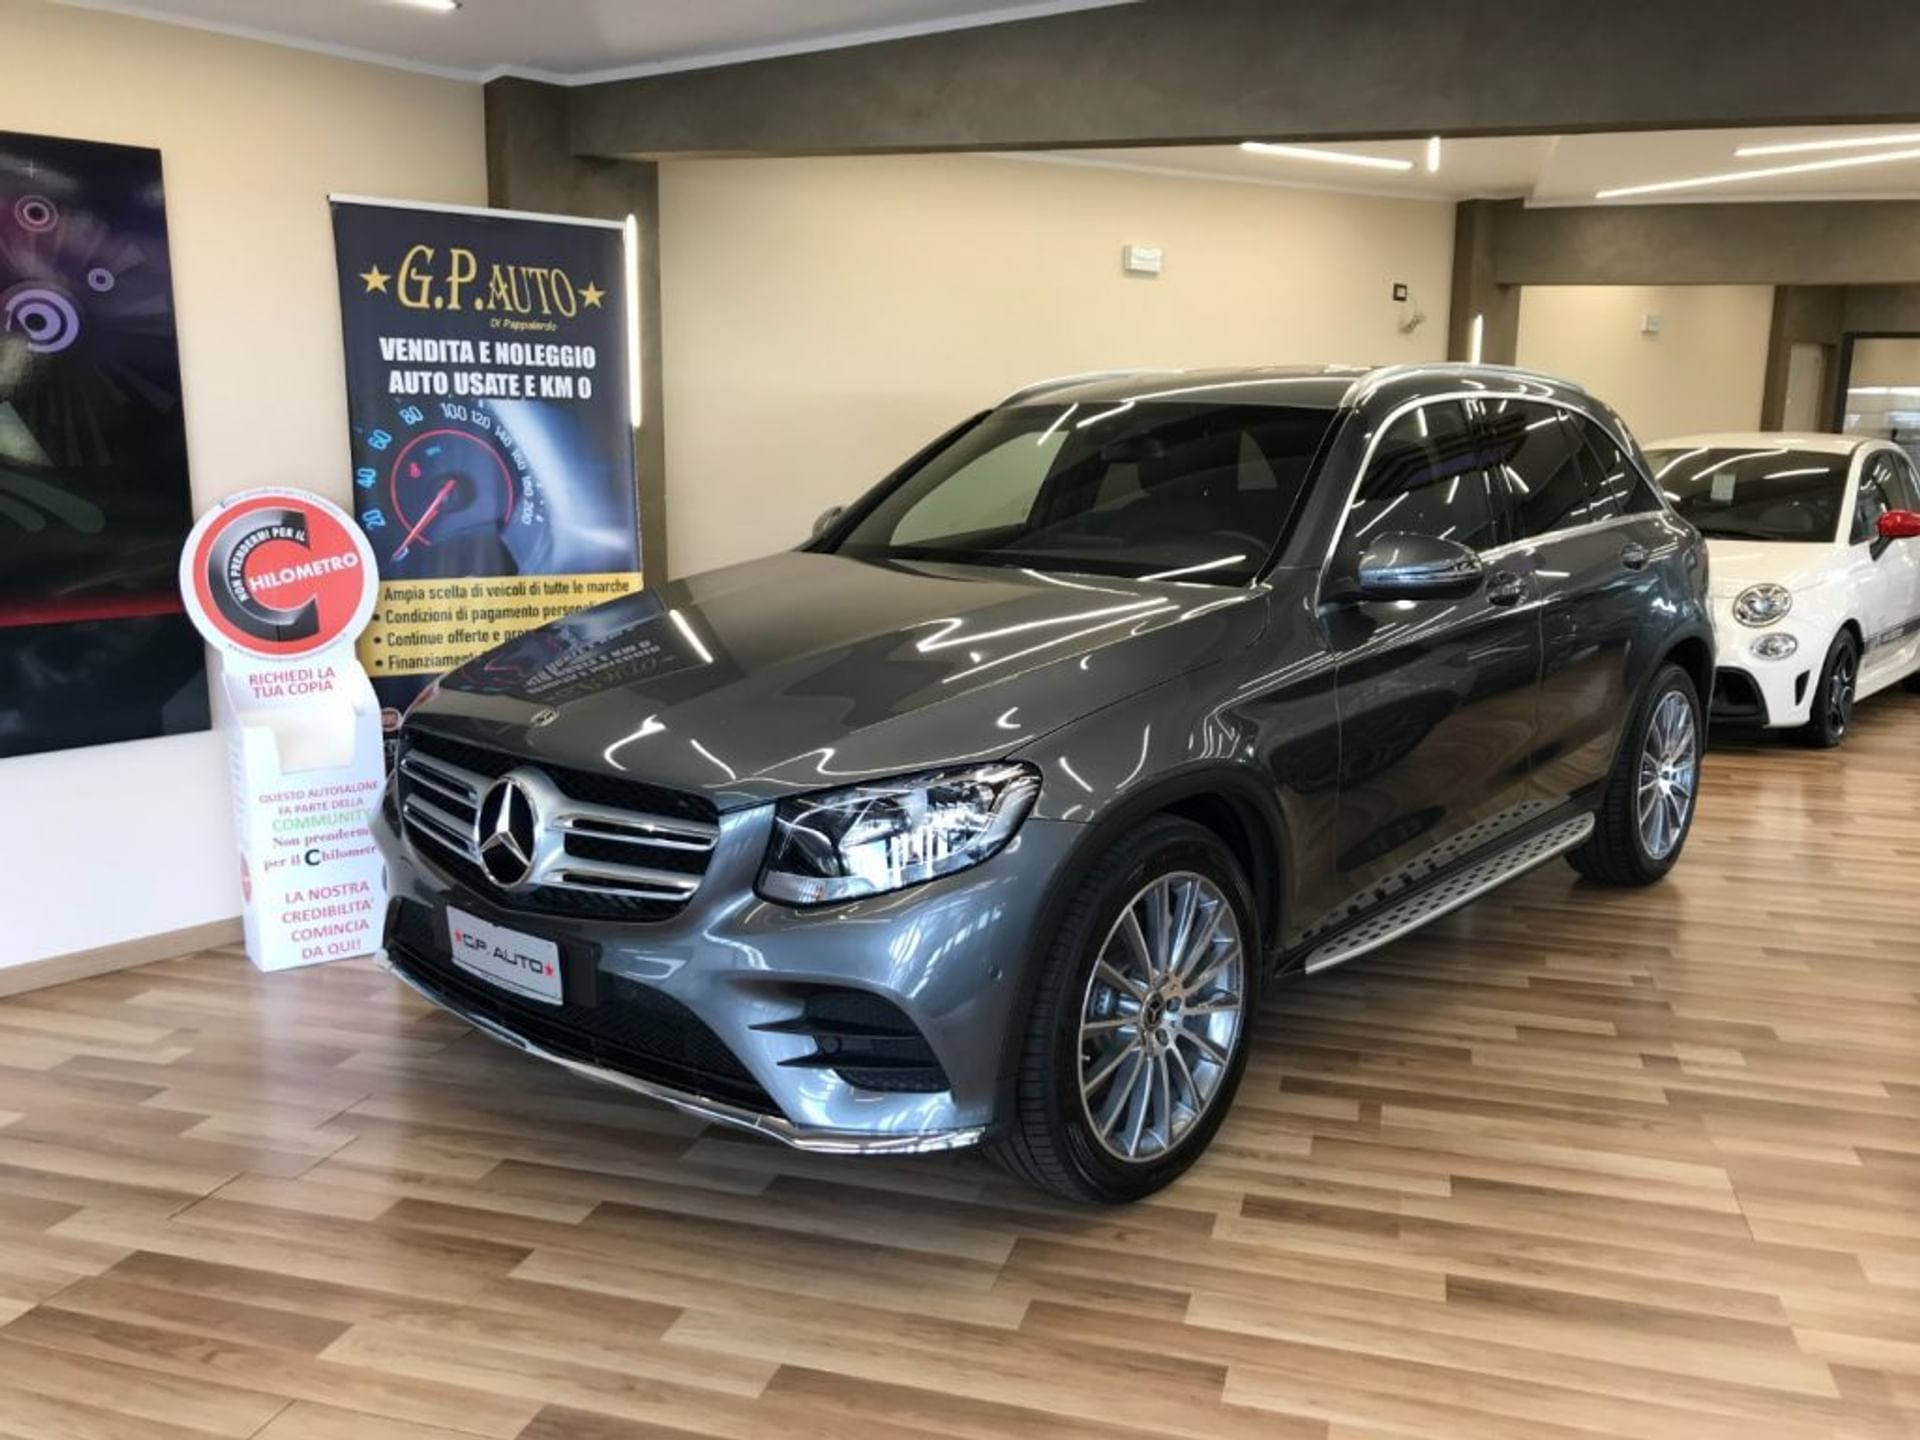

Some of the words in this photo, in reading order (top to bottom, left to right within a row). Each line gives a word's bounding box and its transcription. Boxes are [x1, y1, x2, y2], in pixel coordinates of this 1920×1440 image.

[378, 337, 475, 363] VENDITA
[480, 340, 491, 363] E
[495, 342, 596, 369] NOLEGGIO
[389, 371, 449, 395] AUTO
[453, 372, 520, 397] USATE
[525, 375, 536, 397] E
[540, 376, 573, 399] KM
[577, 377, 592, 399] 0
[399, 405, 424, 425] 80
[441, 402, 468, 421] 100
[470, 410, 491, 430] 120
[368, 429, 392, 450] 60
[357, 468, 376, 488] 40
[362, 509, 386, 530] 20
[271, 526, 294, 538] PER
[231, 529, 270, 577] PRENDERMI
[231, 579, 250, 602] NON
[384, 587, 425, 602] Ampia
[429, 585, 468, 600] scelta
[471, 584, 484, 598] di
[486, 583, 527, 598] veicoli
[529, 581, 541, 596] di
[543, 581, 570, 595] tutte
[573, 580, 584, 594] le
[587, 580, 630, 594] marche
[386, 606, 451, 624] Condizioni
[456, 607, 469, 622] di
[471, 605, 539, 628] pagamento
[387, 631, 442, 648] Continue
[447, 628, 489, 643] offerte
[492, 630, 500, 642] e
[504, 629, 527, 644] pro
[249, 668, 314, 686] RICHIEDI
[318, 666, 336, 680] LA
[254, 684, 284, 699] TUA
[288, 679, 333, 696] COPIA
[258, 789, 305, 804] QUESTO
[308, 780, 379, 798] AUTOSALONE
[278, 804, 292, 816] FA
[294, 802, 329, 814] PARTE
[331, 797, 364, 811] DELLA
[272, 809, 370, 831] COMMUNITY
[273, 835, 300, 849] Non
[263, 856, 286, 872] per
[291, 853, 301, 866] il
[285, 891, 304, 905] LA
[308, 880, 370, 901] NOSTRA
[291, 918, 370, 942] COMINCIA
[301, 944, 324, 960] DA
[327, 939, 361, 957] QUI!
[493, 947, 544, 974] AUTO
